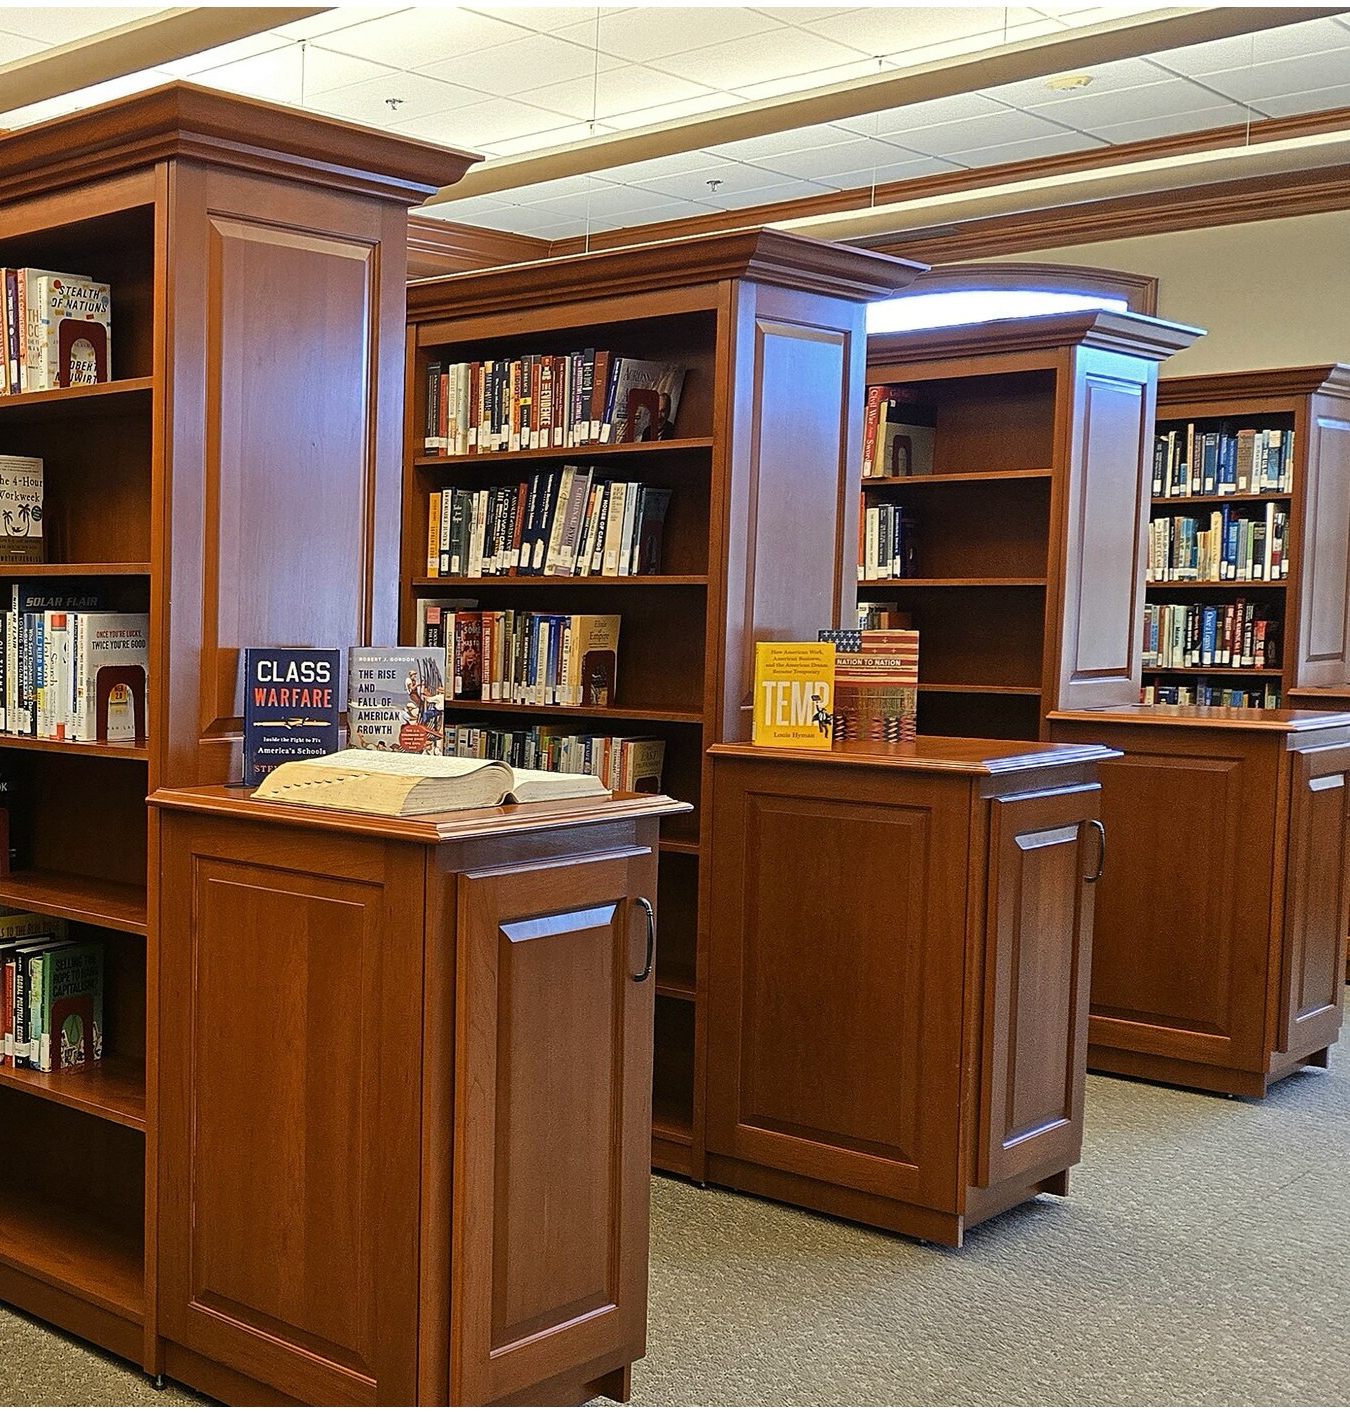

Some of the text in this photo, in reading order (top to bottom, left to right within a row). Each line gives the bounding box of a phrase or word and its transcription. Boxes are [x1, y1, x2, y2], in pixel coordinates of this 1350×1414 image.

[59, 285, 100, 300] STEALTH
[51, 298, 108, 314] OF NATIONS
[869, 389, 879, 408] Civil
[540, 391, 551, 426] EVIDENCE
[867, 408, 877, 425] War
[12, 475, 43, 488] 4-Hour
[502, 498, 510, 518] COLD
[571, 487, 584, 525] CRIMINAL
[600, 499, 608, 520] HOUSE
[595, 530, 603, 552] CARDS
[25, 596, 99, 608] SOLAR FLAIR
[96, 630, 109, 639] ONCE
[109, 630, 126, 638] YOU'RE
[92, 640, 146, 650] TWICE YOU'RE GOOD
[836, 659, 863, 667] NATION
[874, 659, 901, 667] NATION
[257, 660, 332, 684] CLASS
[358, 669, 397, 680] THE RISE
[358, 682, 376, 693] AND
[254, 687, 333, 708] WARFARE
[357, 696, 392, 707] FALL OF
[762, 680, 831, 727] TEMP
[357, 710, 401, 721] AMERICAN
[357, 724, 393, 735] GROWTH
[792, 732, 815, 740] Hyman
[257, 746, 327, 755] America's Schools
[16, 974, 24, 1024] GLOBAL POLITICAL
